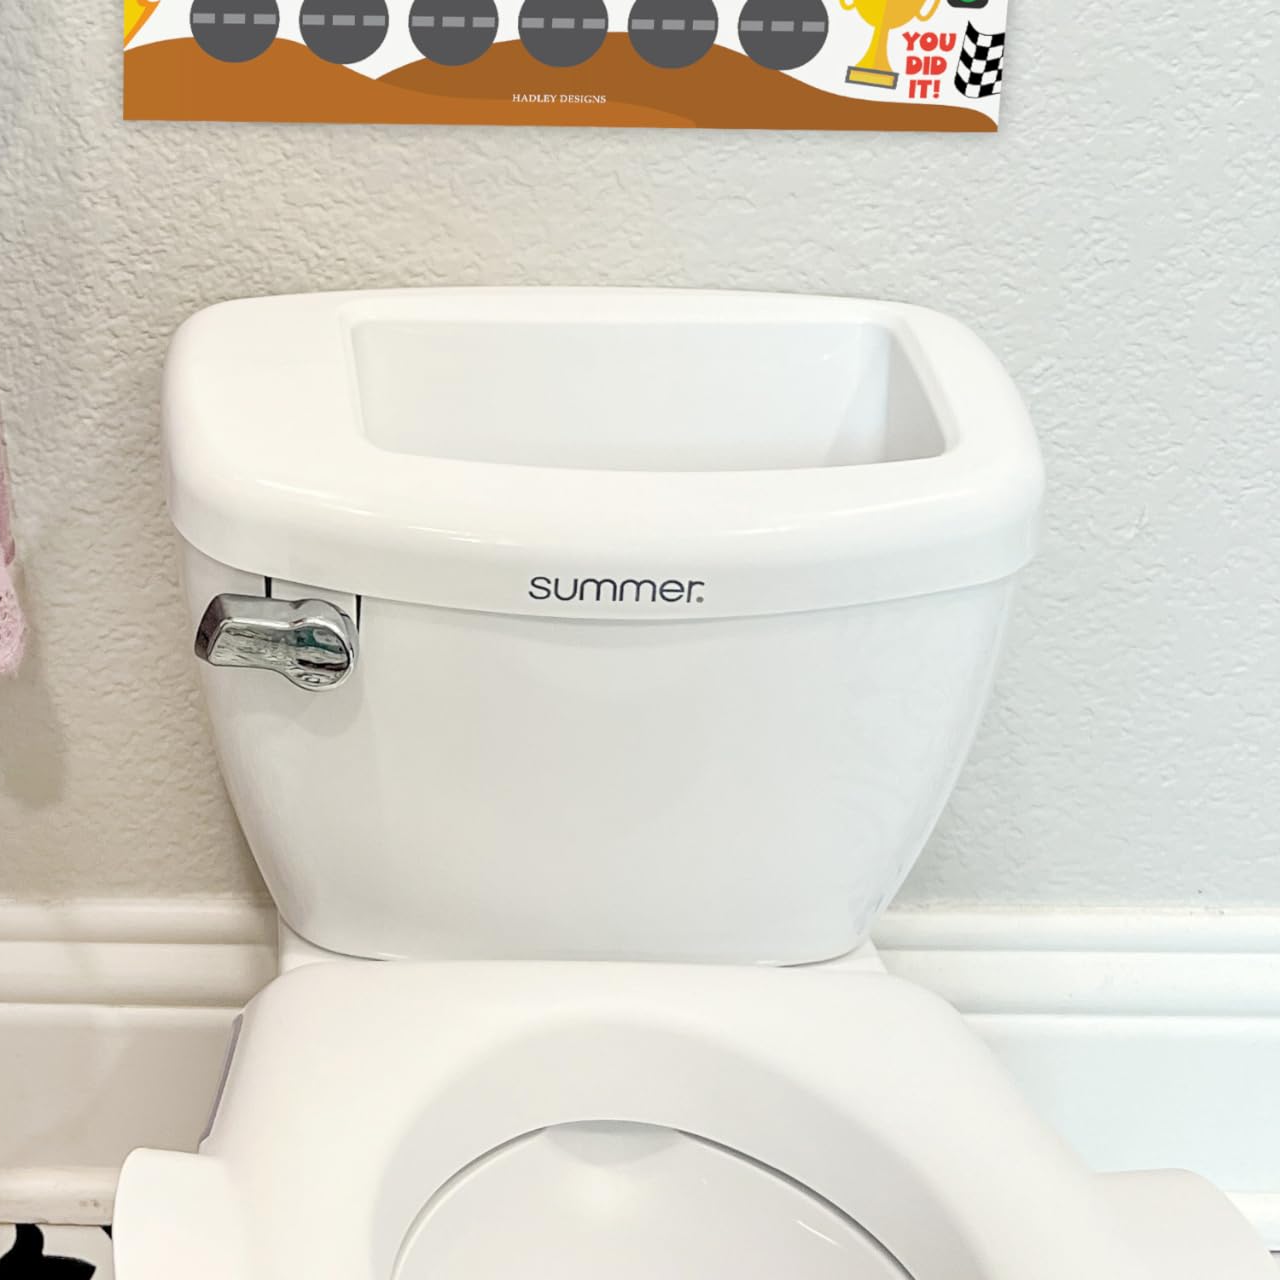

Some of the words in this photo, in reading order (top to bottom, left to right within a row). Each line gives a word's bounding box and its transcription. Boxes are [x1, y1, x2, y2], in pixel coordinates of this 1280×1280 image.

[902, 31, 957, 52] YOU
[905, 56, 947, 75] DID
[512, 93, 558, 103] HADLEY
[560, 94, 607, 104] DESIGNS
[908, 79, 941, 99] IT!
